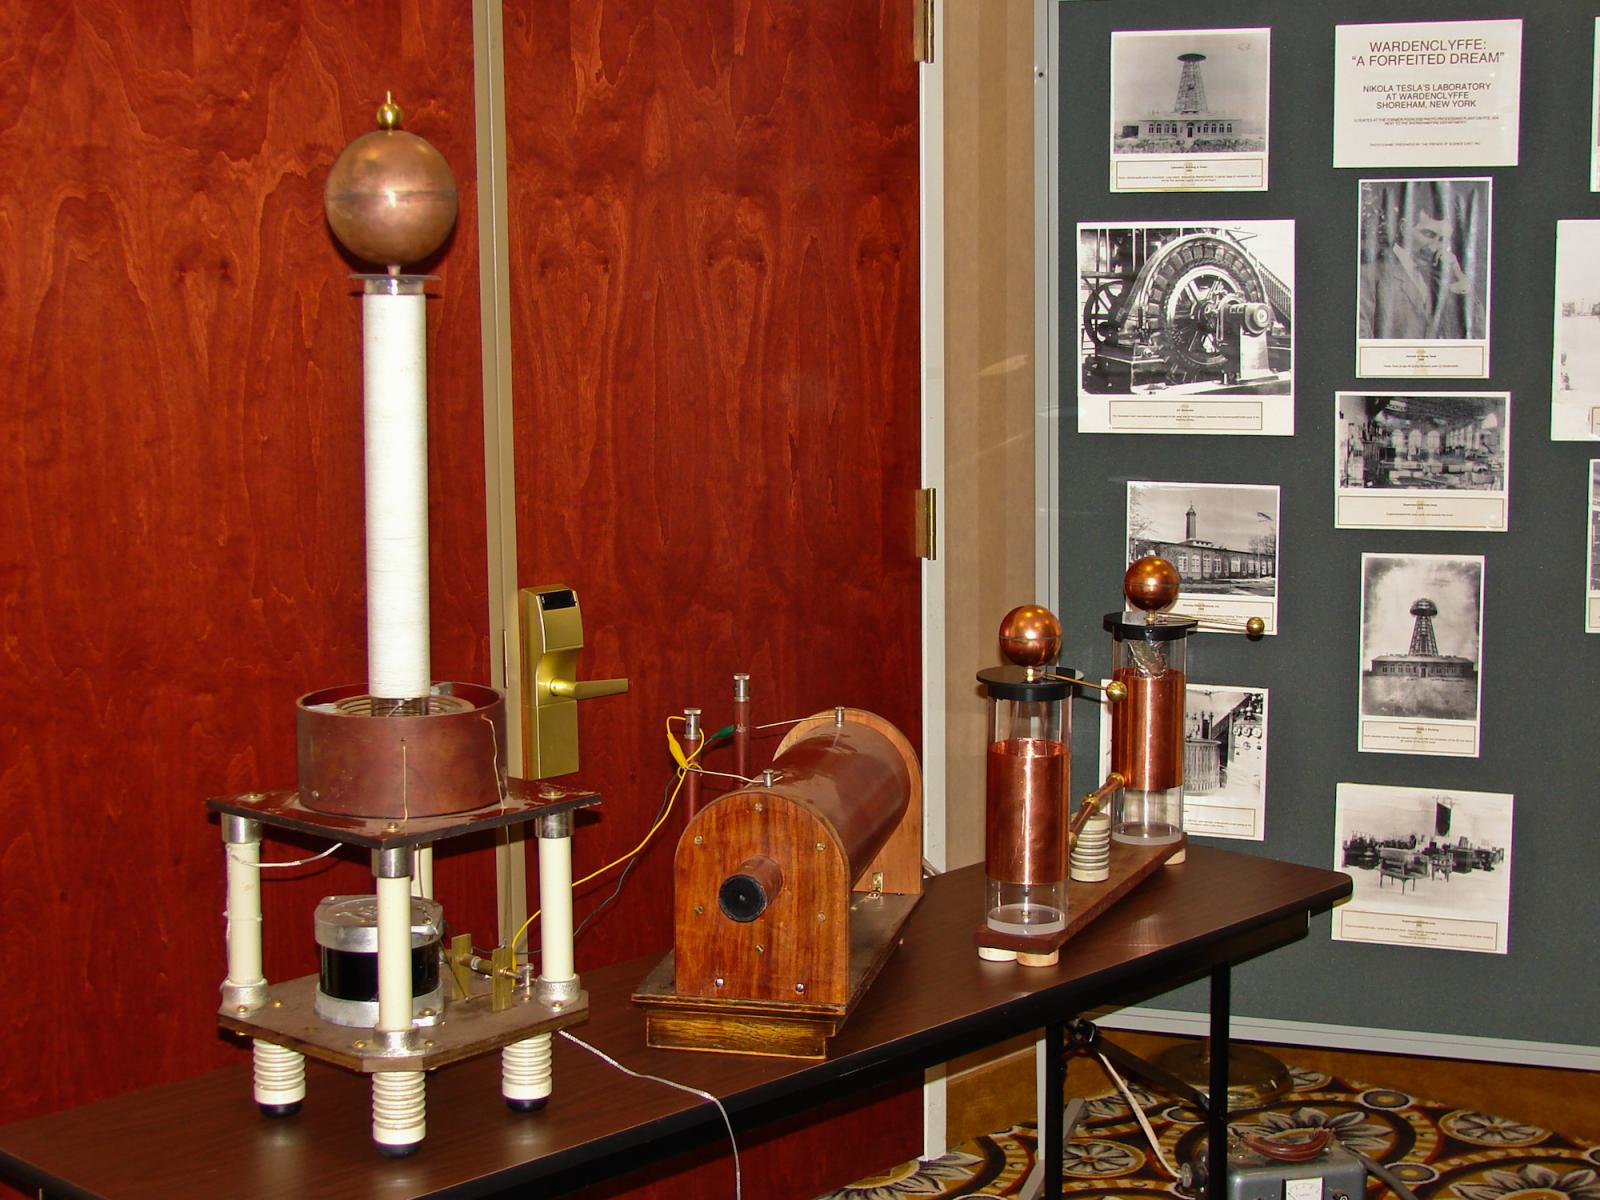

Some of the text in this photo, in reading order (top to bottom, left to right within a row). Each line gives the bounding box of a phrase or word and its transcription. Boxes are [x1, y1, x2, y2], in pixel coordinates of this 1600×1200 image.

[1369, 39, 1487, 53] WARDENCLYFFE:
[1369, 53, 1446, 66] FORFEITED
[1363, 82, 1491, 93] NIKOLA TESLA'S LABORATORY
[1385, 91, 1469, 100] AT WARDENCLYFFE
[1376, 100, 1476, 110] SHOREHAM, NEW YORK
